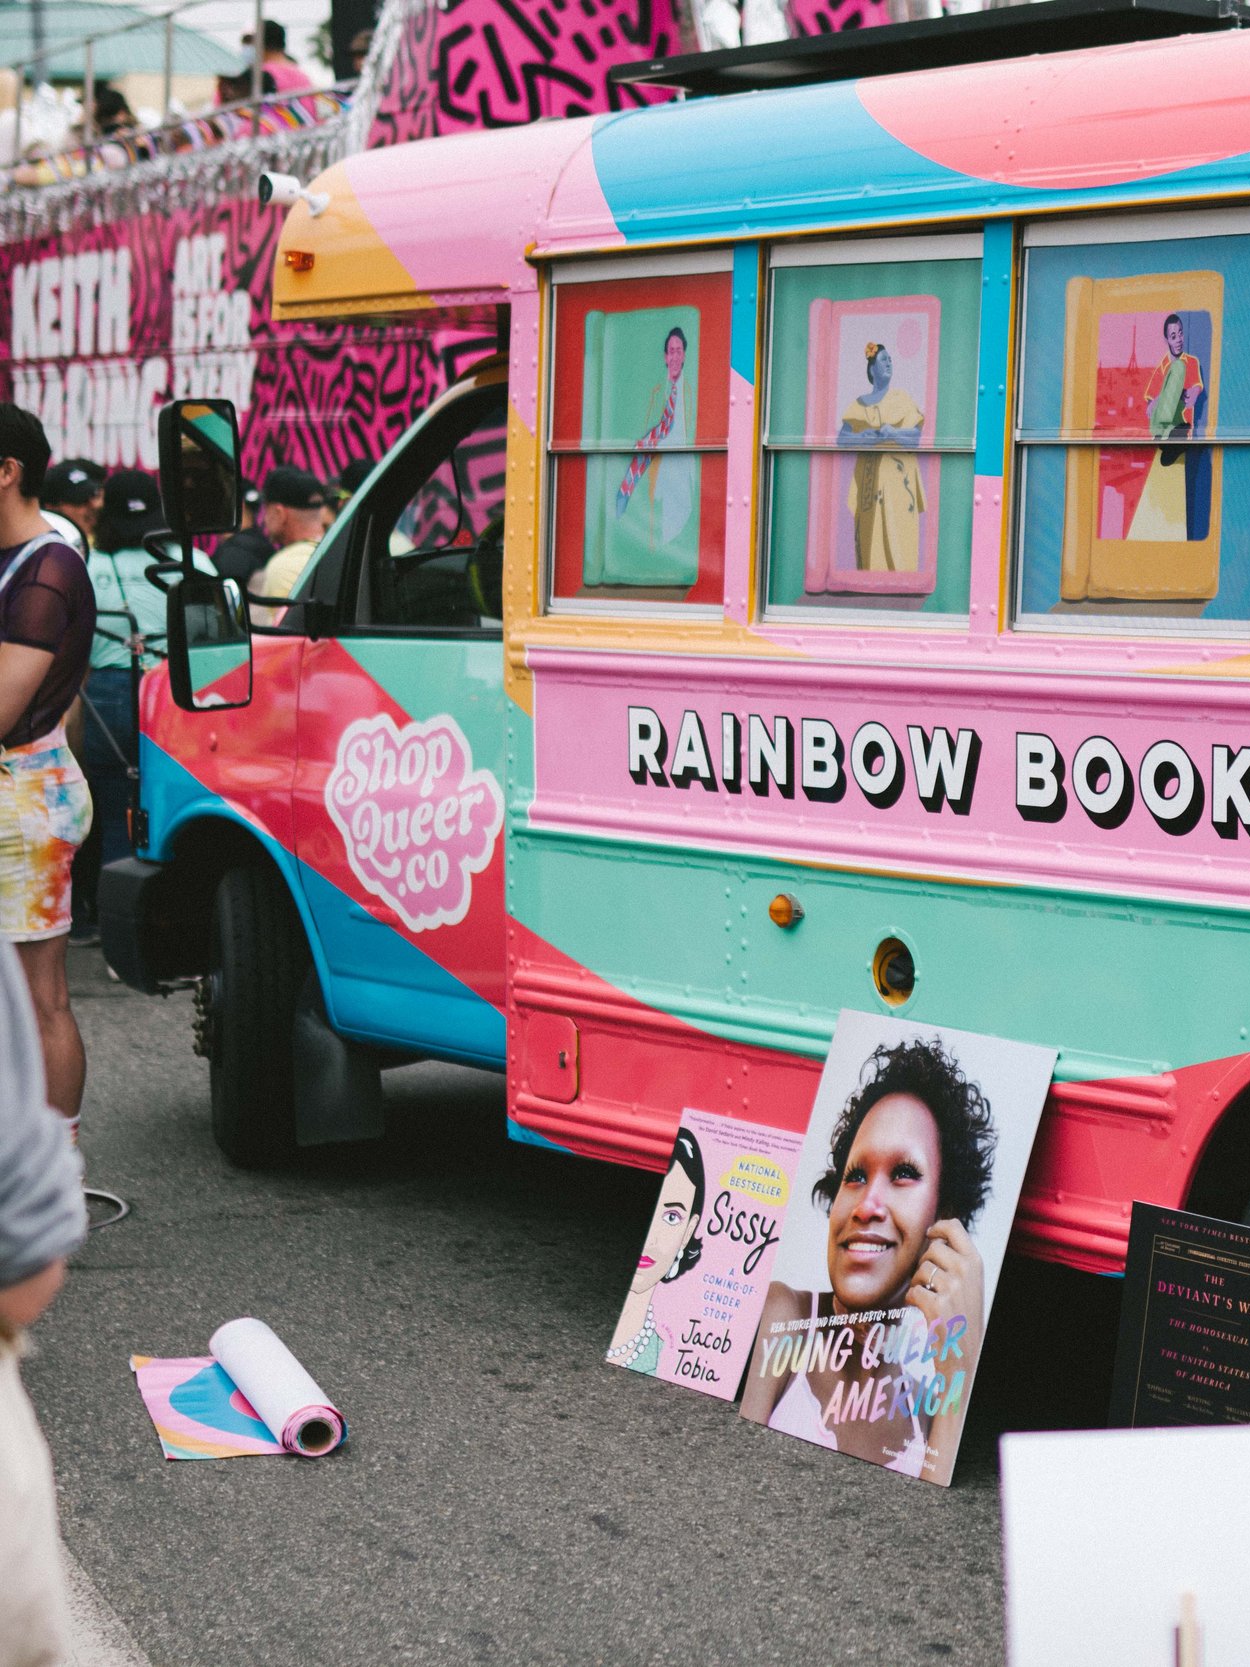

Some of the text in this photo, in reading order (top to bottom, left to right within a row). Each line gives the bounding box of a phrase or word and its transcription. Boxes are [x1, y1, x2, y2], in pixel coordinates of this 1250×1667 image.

[12, 246, 131, 358] KEITH
[199, 289, 250, 349] FOR
[334, 734, 452, 807] Shop
[628, 705, 983, 816] RAINBOW
[352, 789, 485, 879] Queer
[398, 850, 449, 897] .co
[729, 1175, 782, 1198] BESTSELLER
[738, 1160, 781, 1181] NATIONAL
[706, 1190, 780, 1276] Sissy
[1162, 1218, 1176, 1227] NEW
[1180, 1222, 1200, 1233] YORK
[1202, 1227, 1227, 1239] TIMES
[728, 1267, 735, 1276] A
[1204, 1273, 1225, 1286] THE
[703, 1290, 741, 1309] GENDER
[1157, 1280, 1233, 1310] DEVIANT'S
[703, 1306, 734, 1323] STORY
[848, 1312, 858, 1325] OF
[681, 1318, 732, 1355] Jacob
[759, 1314, 968, 1378] YOUNG QUEER
[1169, 1318, 1249, 1346] THE HOMOSEXUAL
[674, 1349, 721, 1383] Tobia
[1161, 1348, 1250, 1380] THE UNITED STATES
[1176, 1369, 1231, 1391] OF AMERICA
[821, 1370, 967, 1426] AMERICA
